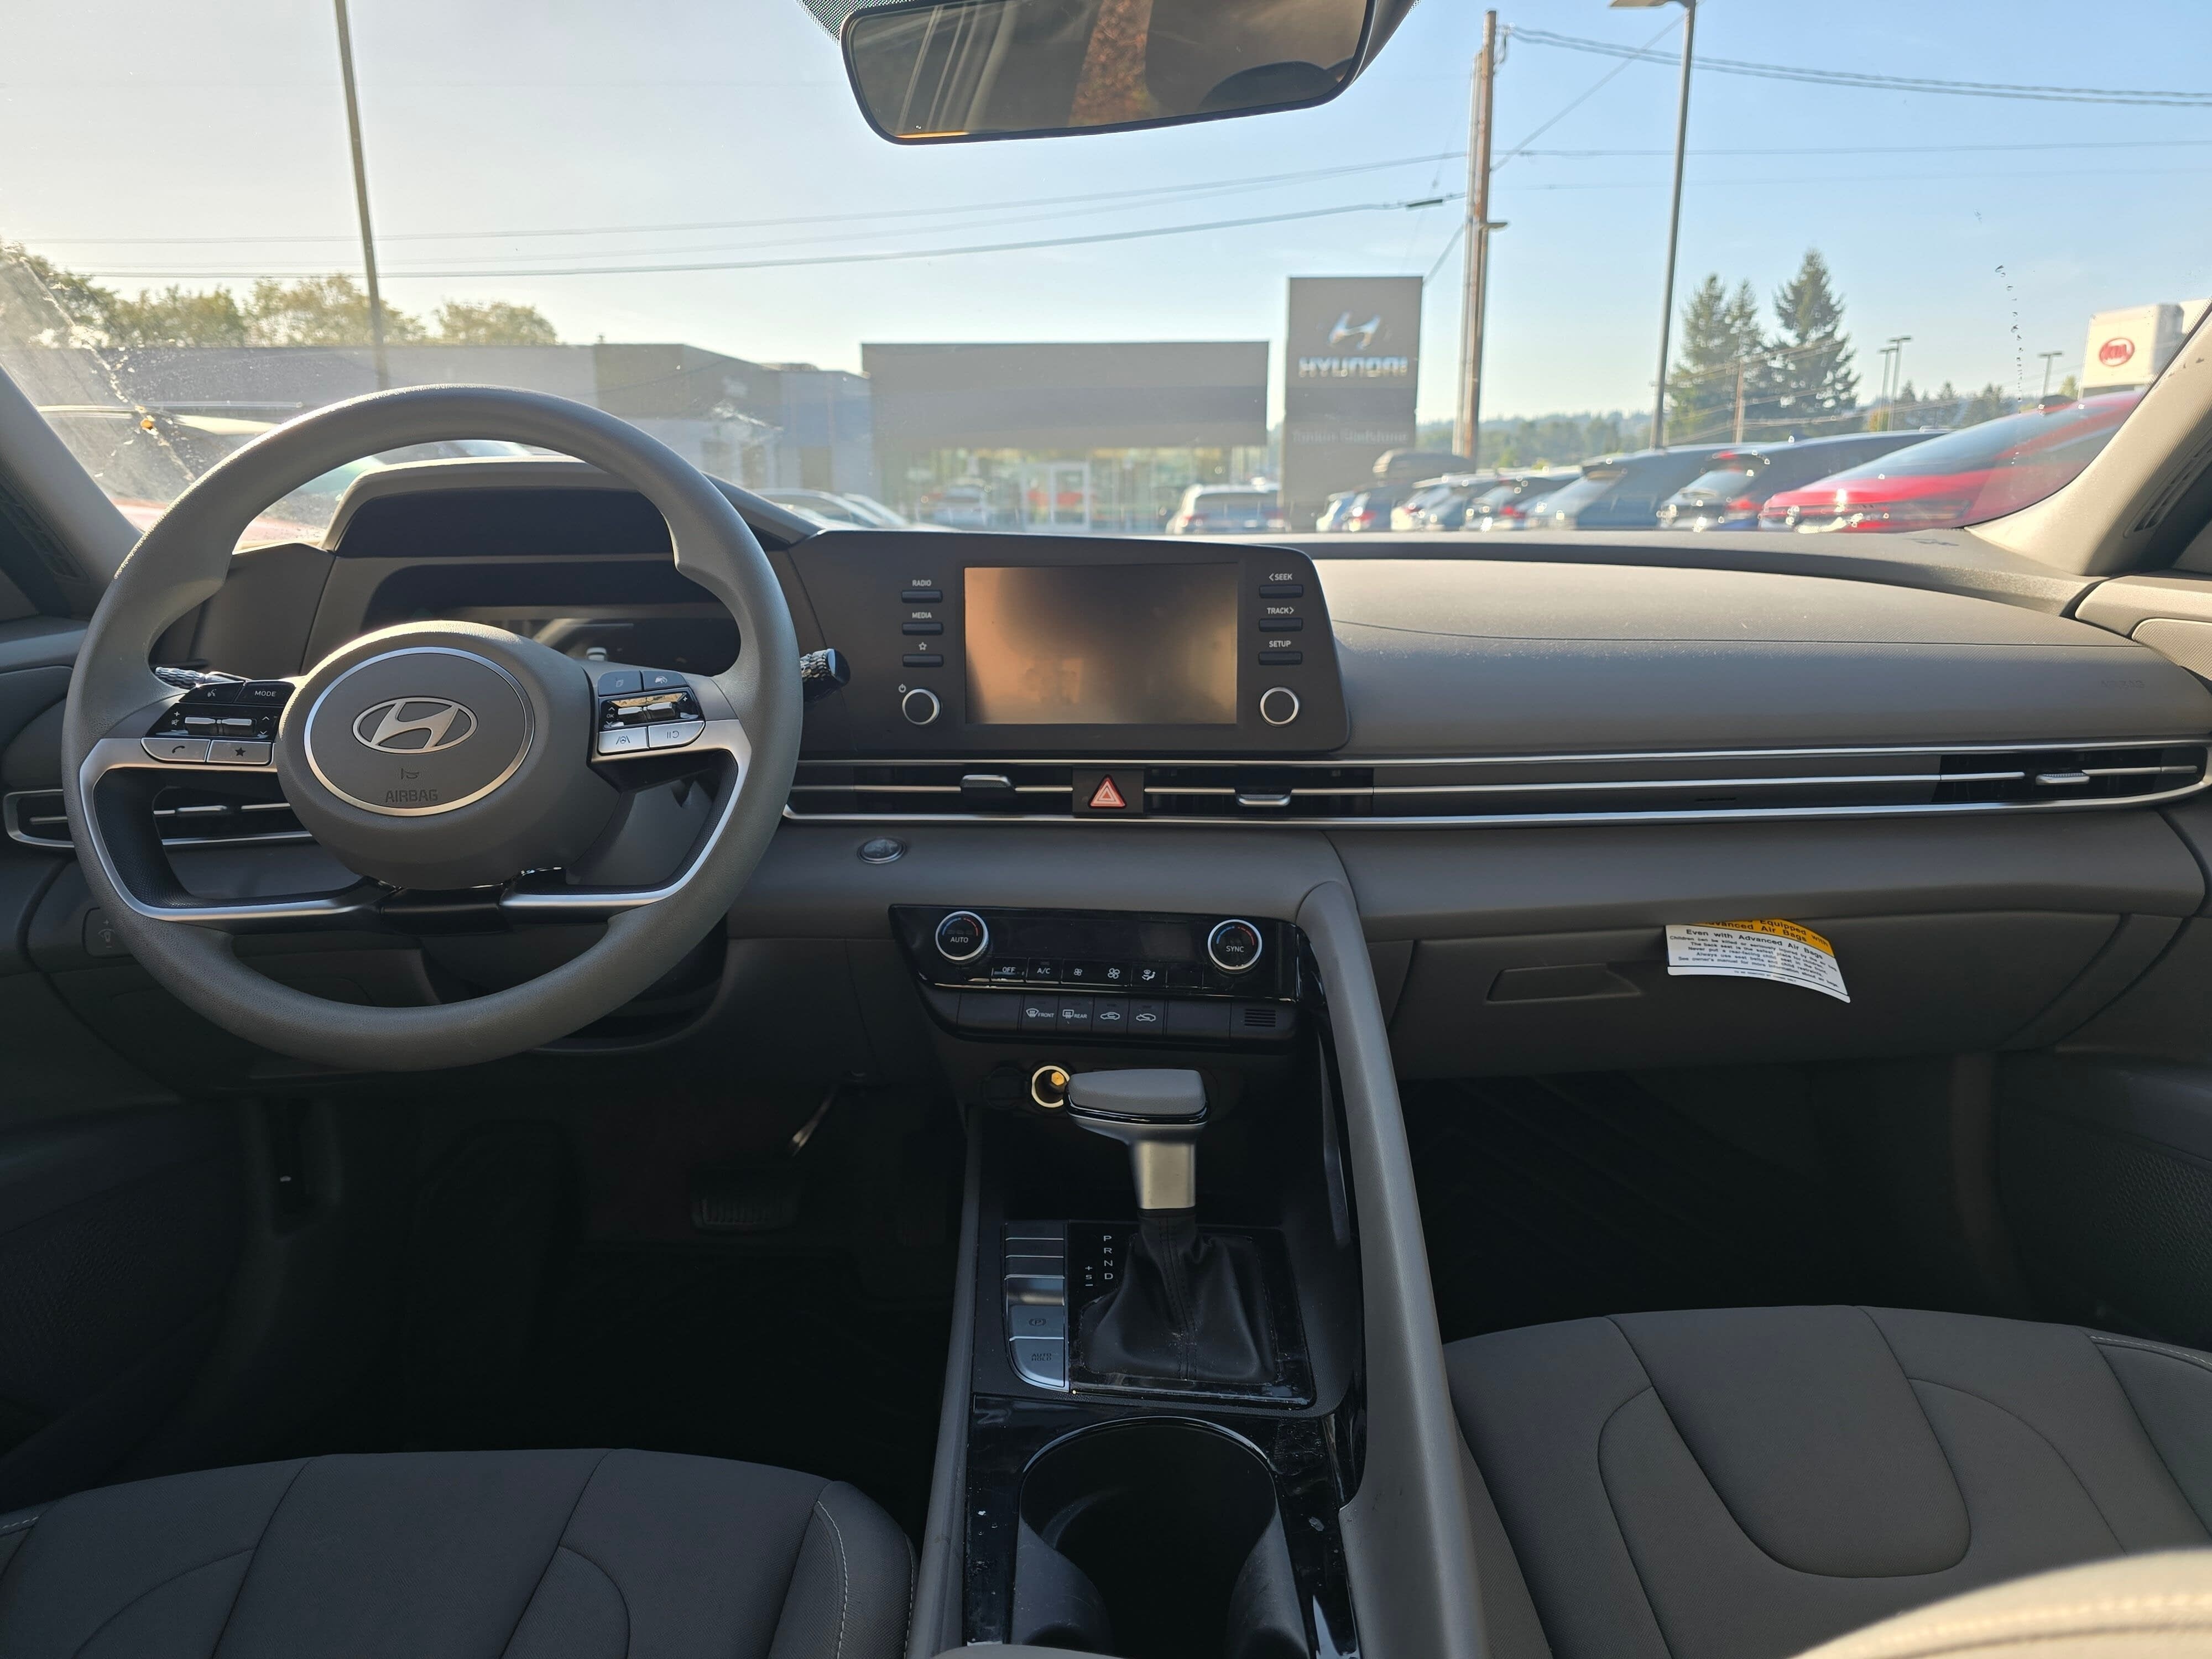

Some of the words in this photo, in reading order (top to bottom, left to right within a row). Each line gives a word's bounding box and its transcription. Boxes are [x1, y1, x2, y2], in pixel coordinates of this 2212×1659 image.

[1299, 357, 1407, 377] HYUNDAI
[385, 789, 438, 802] AIRBAG
[1705, 921, 1754, 930] vanced
[1783, 930, 1807, 942] Bags
[1760, 920, 1806, 935] Equipped
[1739, 935, 1782, 946] Advanced
[1804, 947, 1823, 959] Bags
